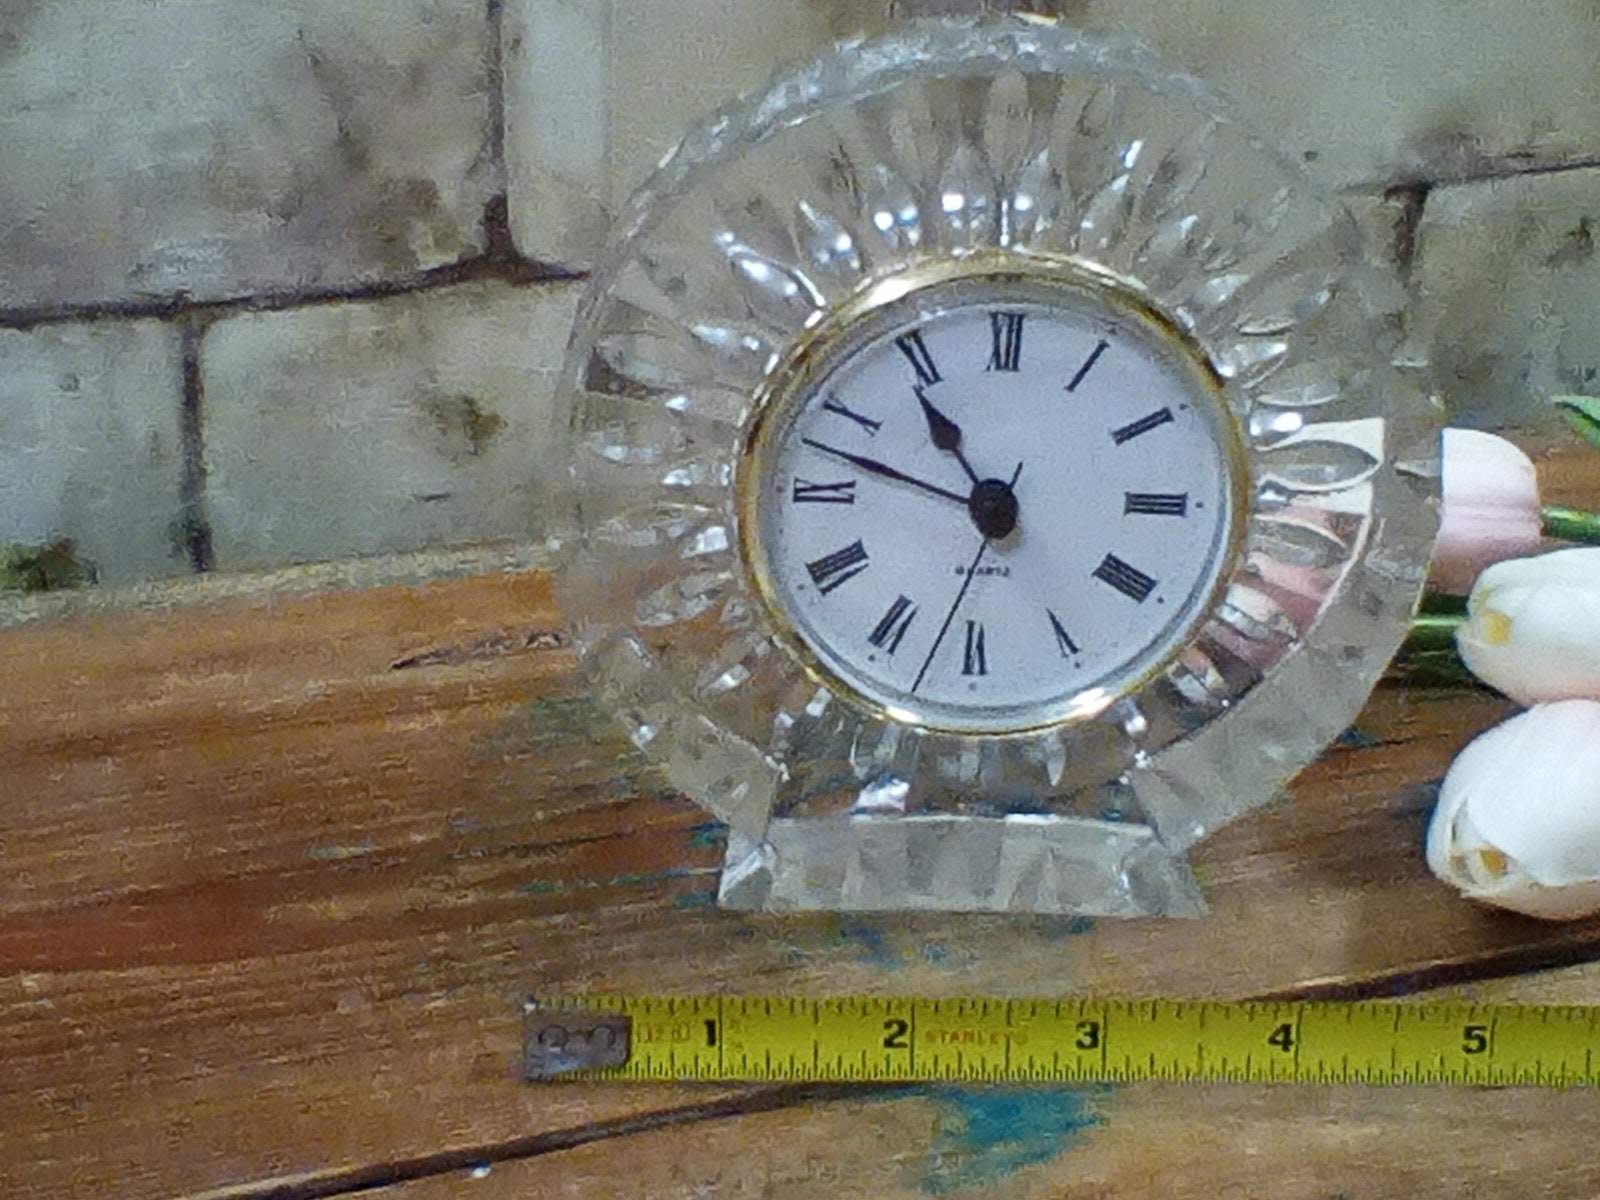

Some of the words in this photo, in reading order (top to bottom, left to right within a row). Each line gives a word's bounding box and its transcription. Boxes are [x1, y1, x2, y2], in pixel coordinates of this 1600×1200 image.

[895, 328, 945, 392] XI
[986, 312, 1024, 372] XII
[822, 394, 885, 438] X
[1110, 406, 1176, 446] II
[793, 475, 857, 505] IX
[1123, 491, 1188, 517] III
[805, 538, 870, 596] VIII
[868, 594, 920, 657] VII
[1045, 606, 1080, 658] V
[961, 619, 988, 676] VI
[703, 1018, 717, 1048] 1
[883, 1018, 910, 1049] 2
[1075, 1019, 1100, 1051] 3
[1267, 1021, 1296, 1053] 4
[1461, 1024, 1488, 1055] 5
